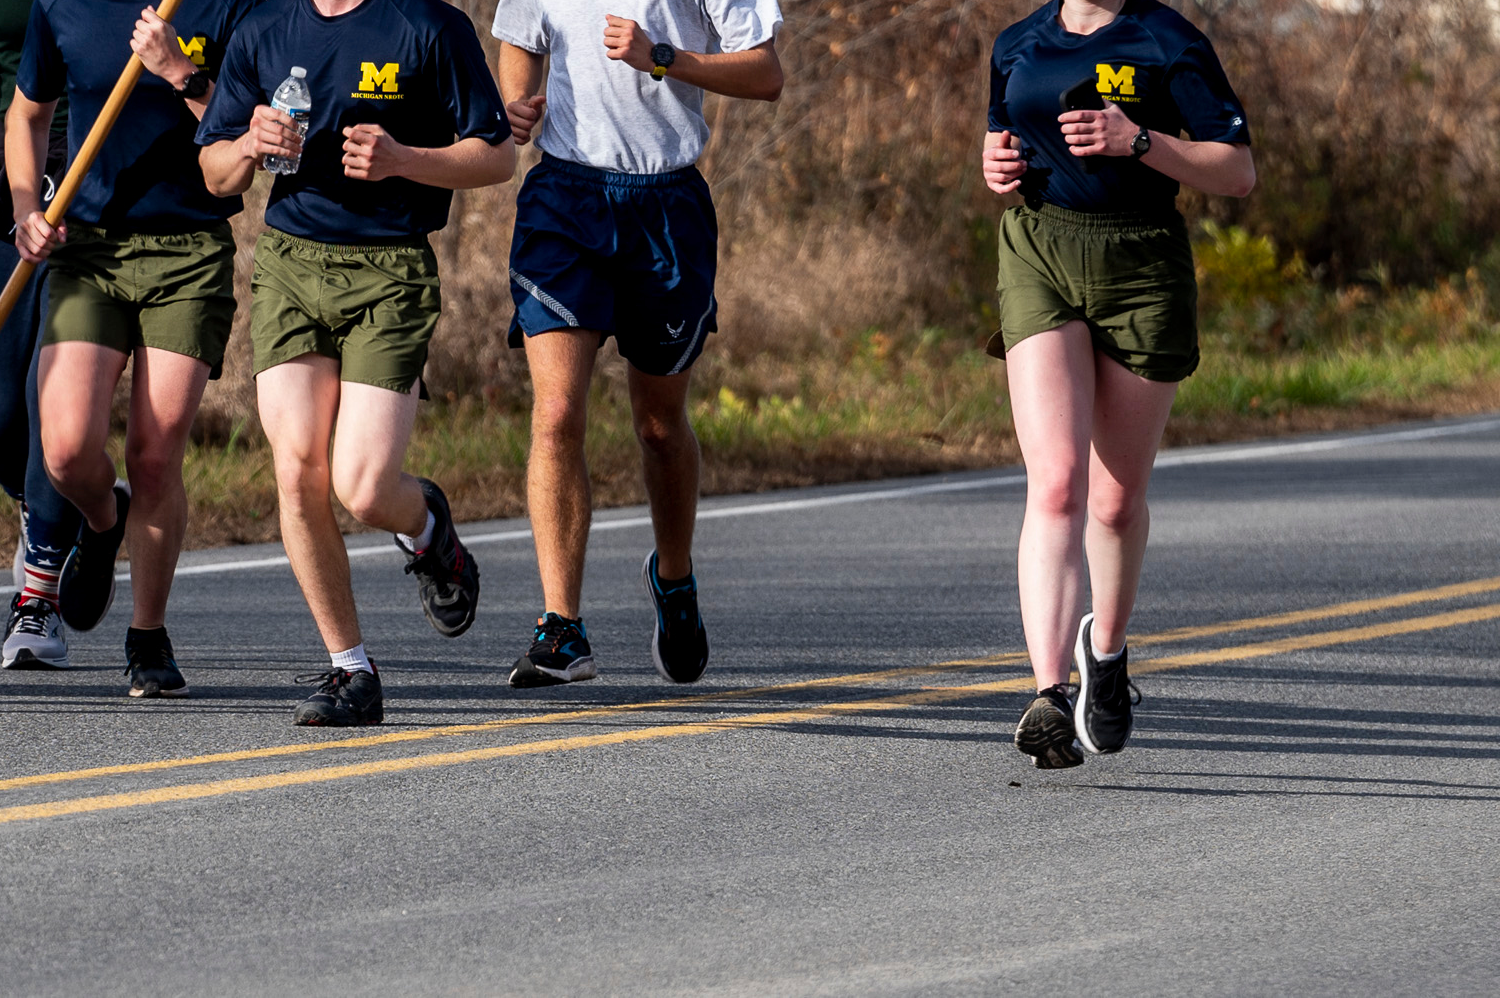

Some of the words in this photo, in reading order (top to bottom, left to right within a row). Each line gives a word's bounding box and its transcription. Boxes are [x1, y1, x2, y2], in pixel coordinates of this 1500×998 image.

[358, 61, 400, 92] M
[1095, 63, 1136, 95] M
[350, 92, 383, 100] MICHIGAN
